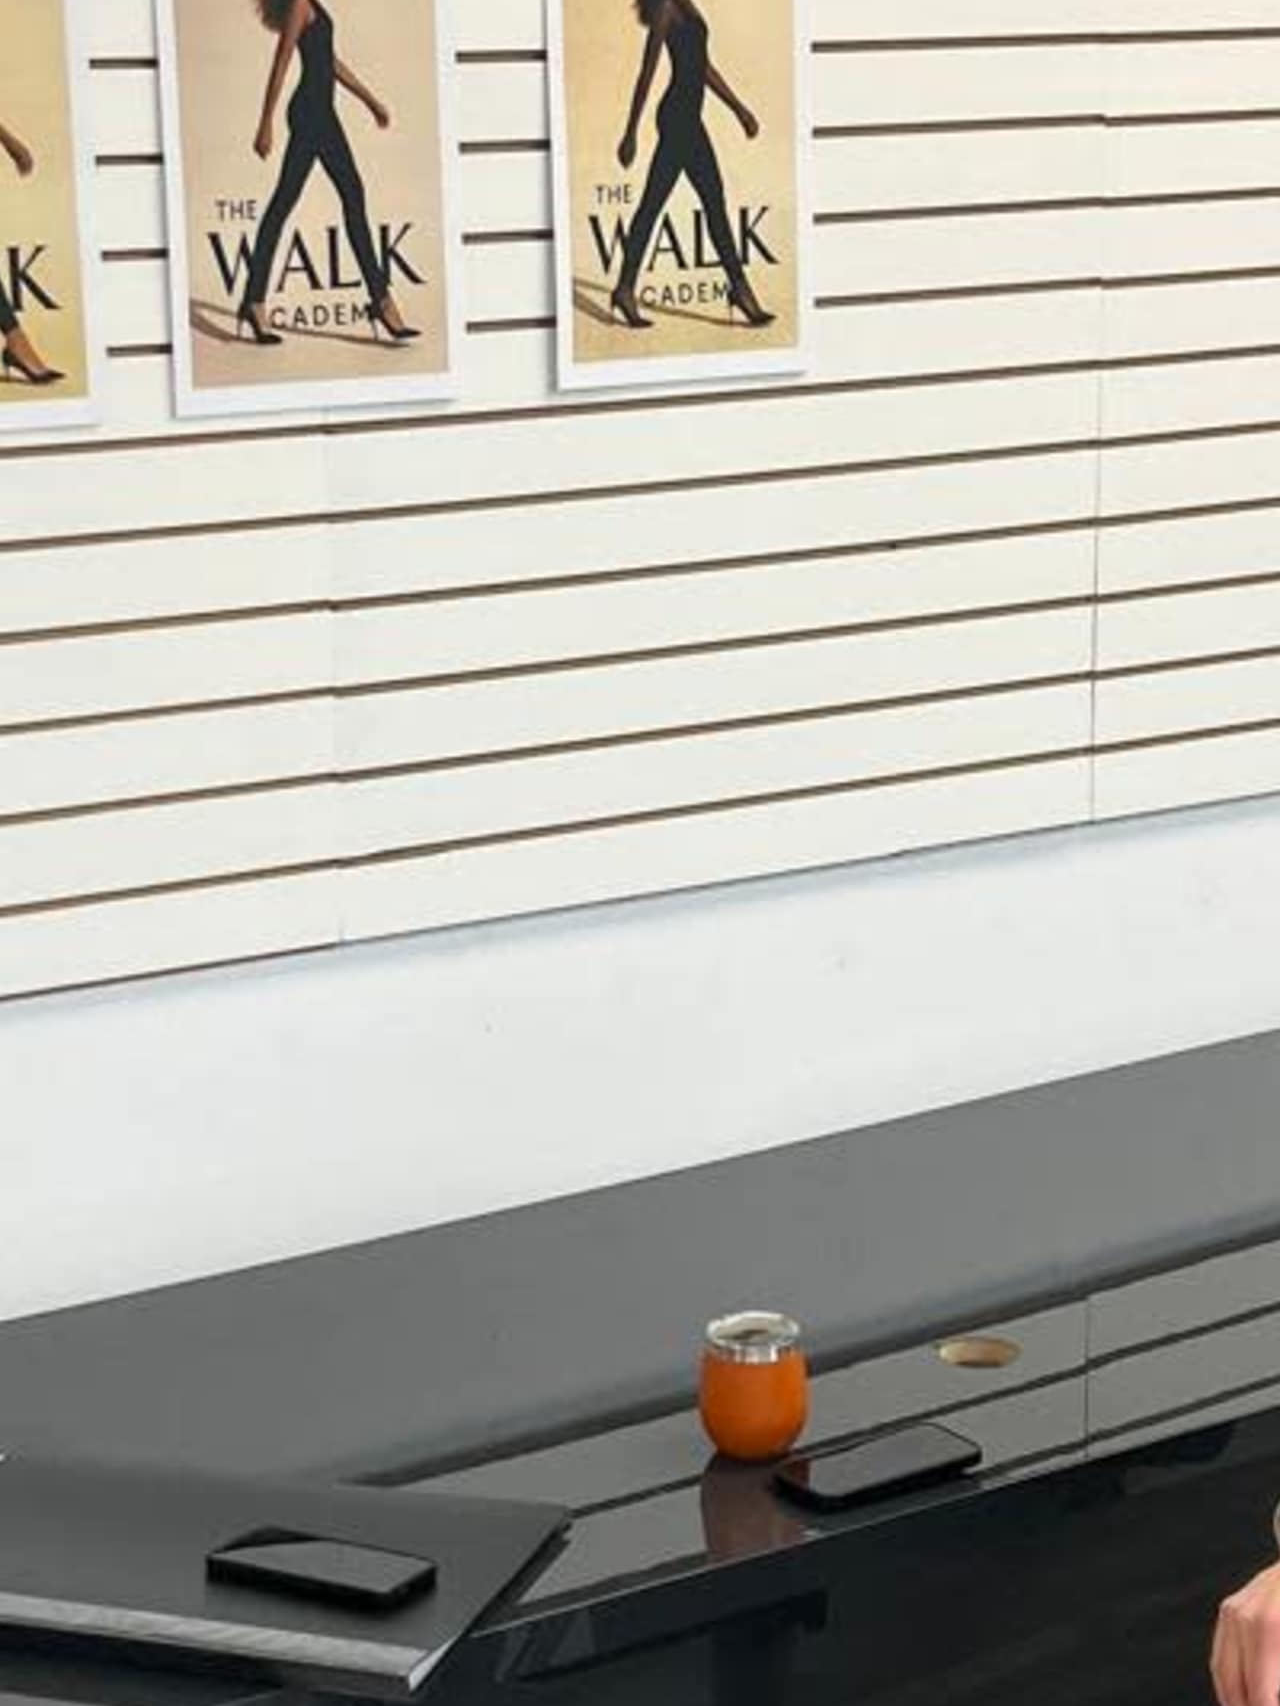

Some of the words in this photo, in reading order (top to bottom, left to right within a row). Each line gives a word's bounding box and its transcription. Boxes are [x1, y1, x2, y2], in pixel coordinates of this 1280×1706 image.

[215, 199, 257, 221] THE
[596, 185, 632, 204] THE
[207, 222, 427, 296] WALK
[588, 205, 780, 275] WALK
